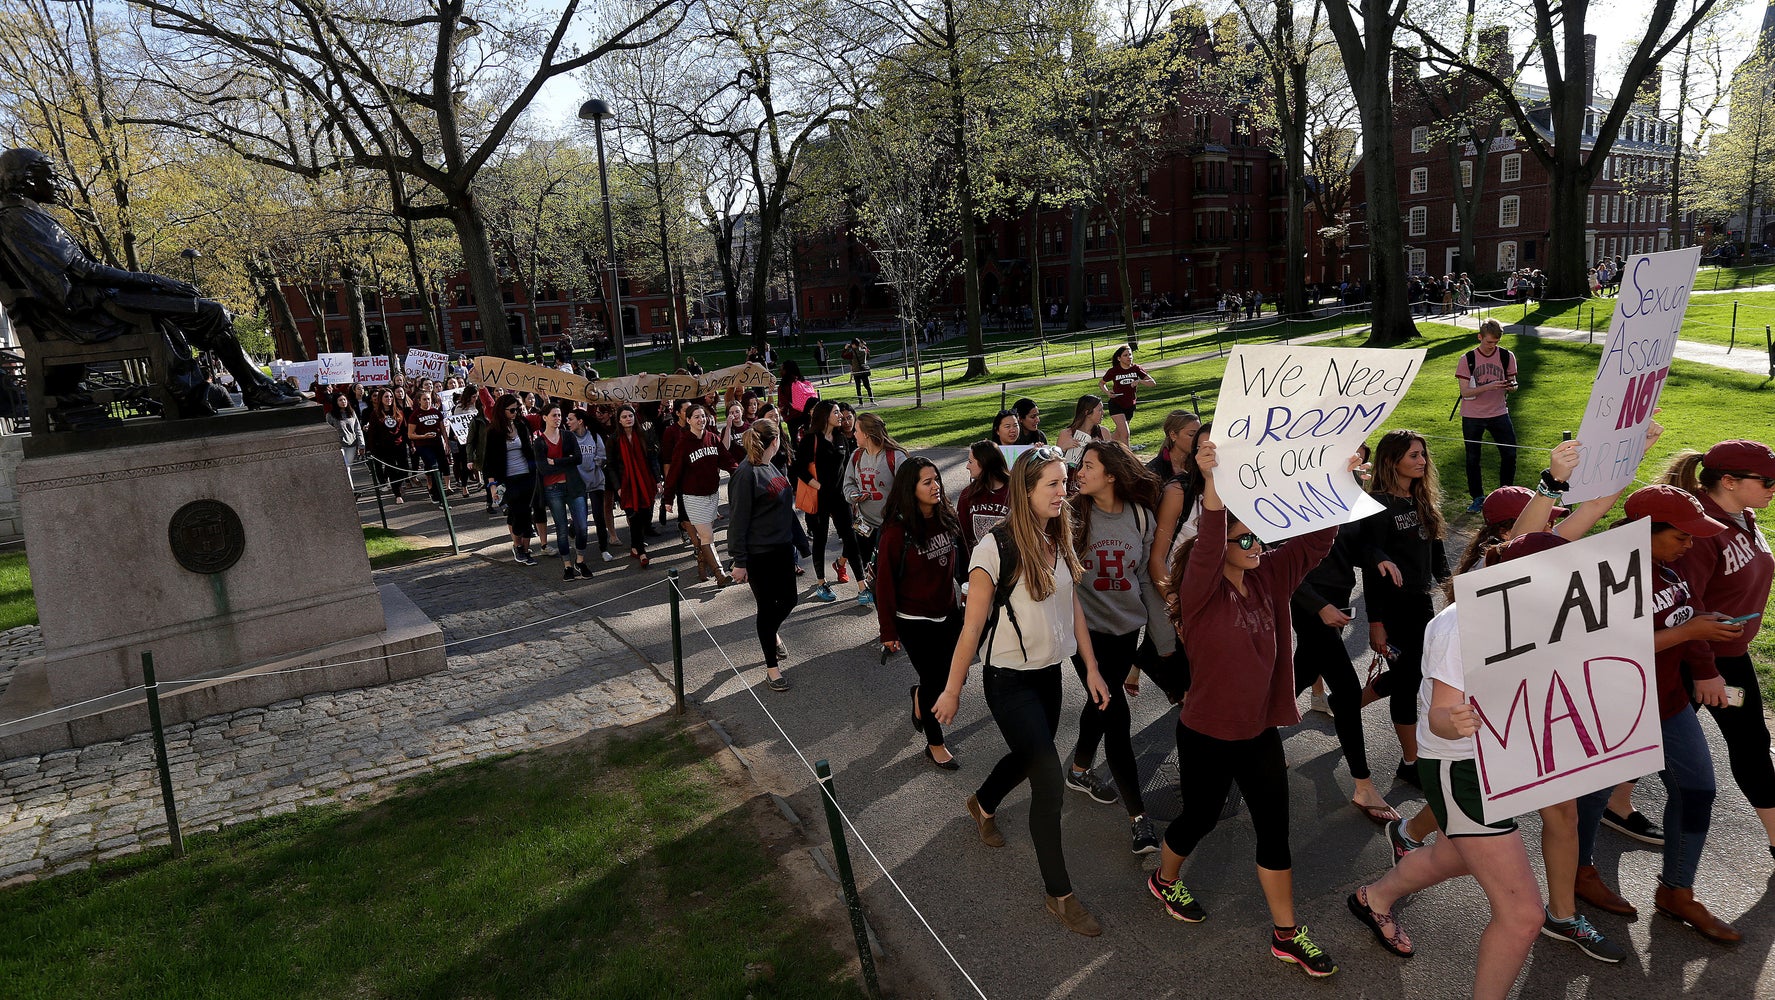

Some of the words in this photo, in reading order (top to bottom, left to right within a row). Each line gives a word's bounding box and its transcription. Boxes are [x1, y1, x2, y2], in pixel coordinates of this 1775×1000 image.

[1621, 253, 1698, 318] Sexual
[371, 357, 388, 366] Her
[423, 358, 443, 371] NOT
[480, 359, 574, 397] WOMEN'S
[656, 377, 691, 400] KEEP
[740, 366, 770, 385] SAF
[1240, 354, 1307, 398] We
[1319, 358, 1414, 397] Need
[1596, 395, 1614, 418] is
[1614, 365, 1669, 431] NOT
[1227, 415, 1251, 440] a
[1255, 402, 1387, 446] ROOM
[688, 446, 719, 463] HARVARD
[1238, 451, 1268, 489] of
[1280, 443, 1335, 477] our
[1254, 473, 1350, 529] OWN
[1088, 539, 1123, 552] PROPERTY
[1124, 543, 1134, 551] OF
[1096, 549, 1125, 579] H
[1127, 560, 1136, 569] A
[1108, 580, 1121, 590] 16
[1475, 575, 1537, 666] I
[1547, 548, 1645, 645] AM
[1469, 656, 1647, 795] MAD
